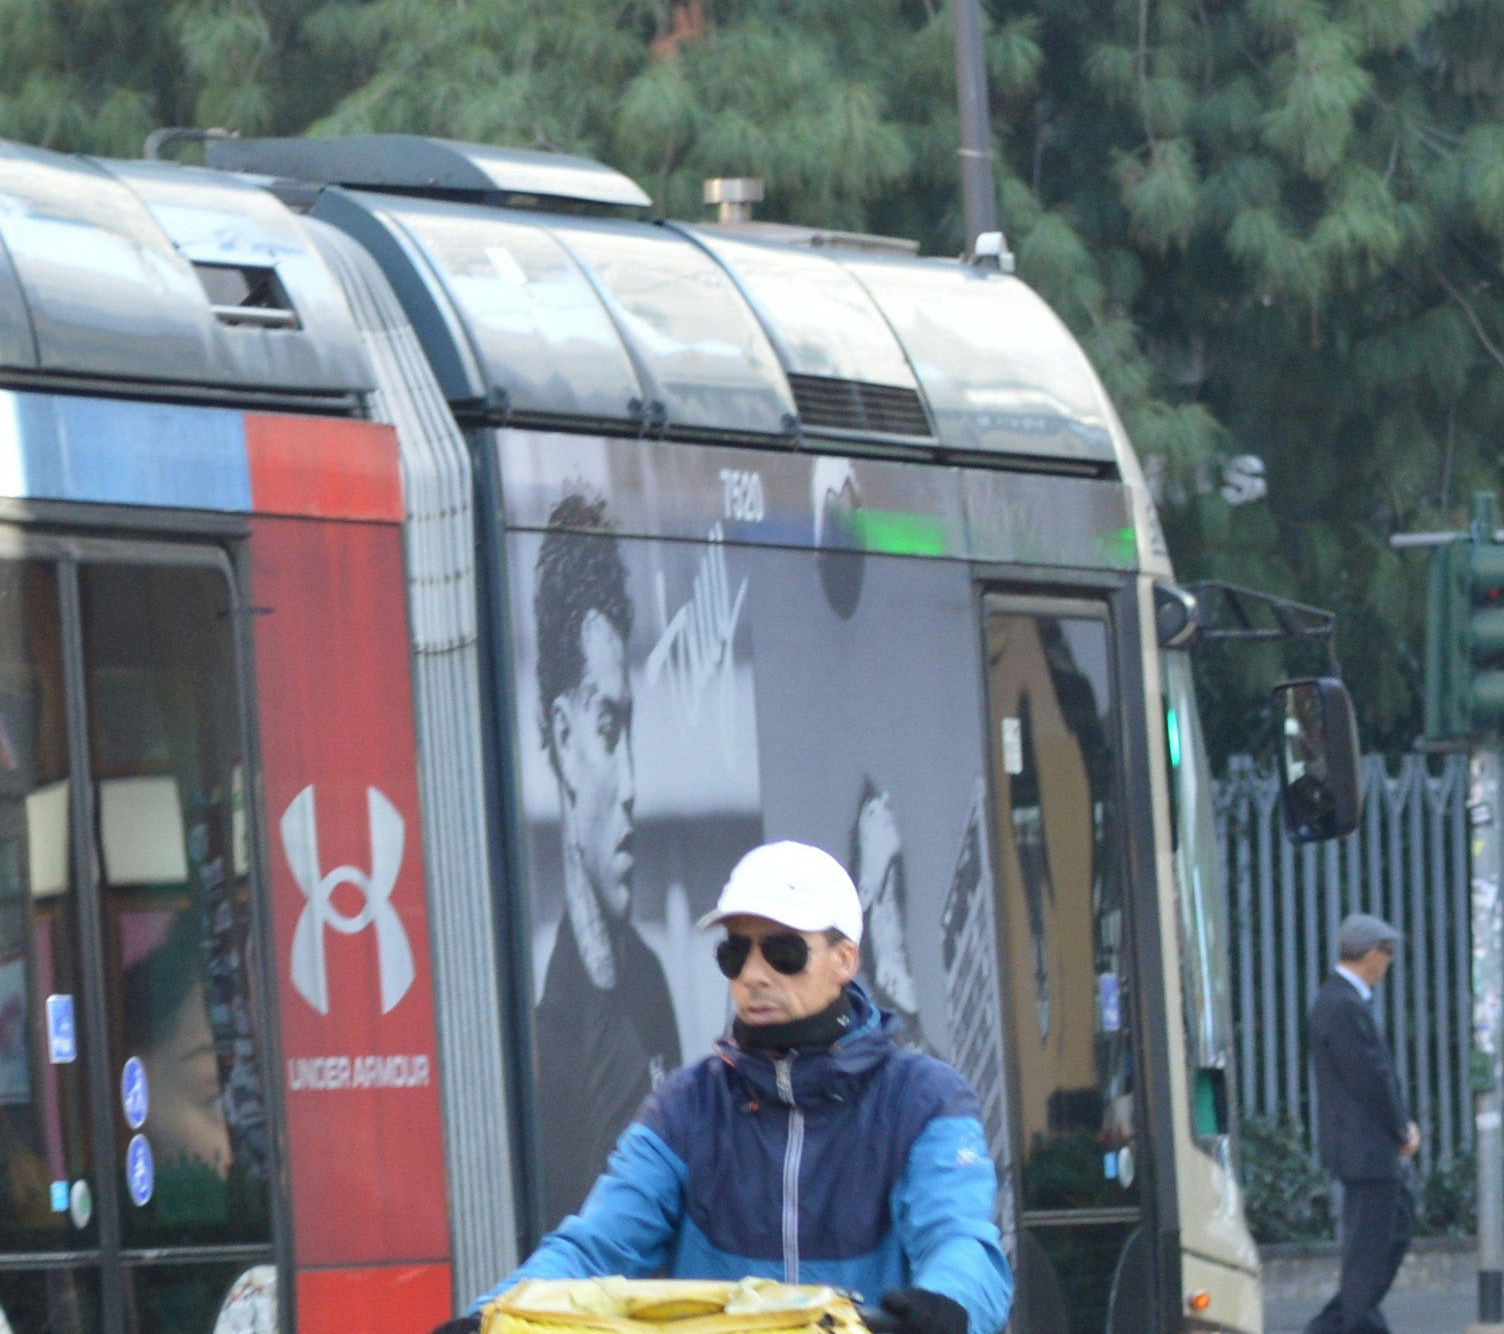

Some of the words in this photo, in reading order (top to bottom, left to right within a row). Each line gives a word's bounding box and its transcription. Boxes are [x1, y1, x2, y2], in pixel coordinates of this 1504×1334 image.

[719, 470, 765, 522] 7520
[288, 1055, 351, 1091] UNDER
[353, 1053, 430, 1088] ARMOUR
